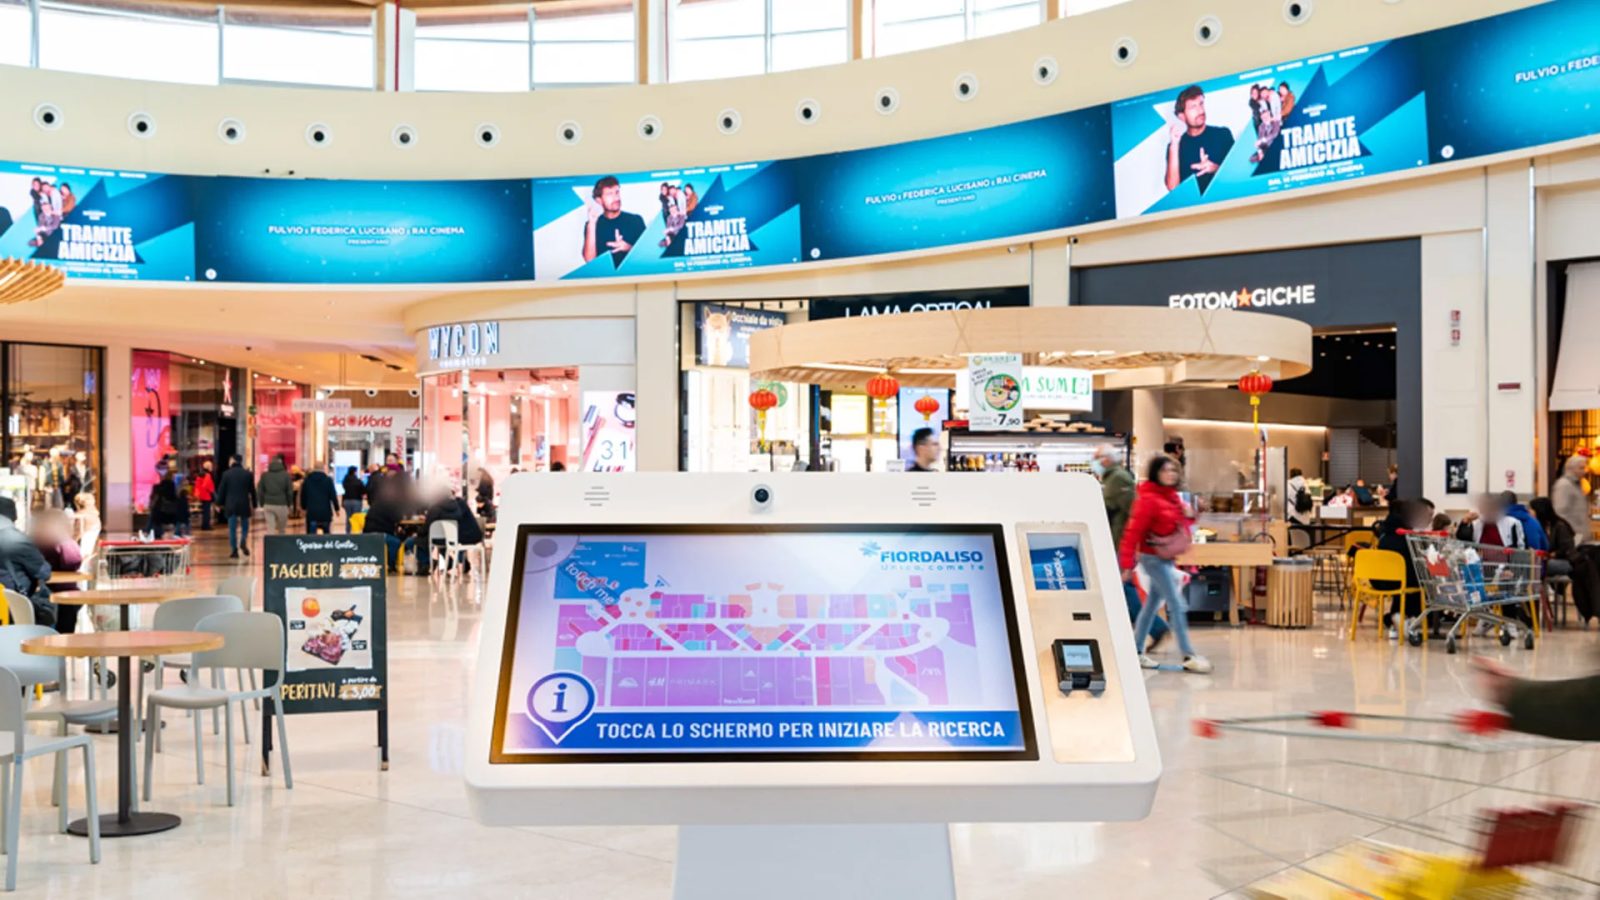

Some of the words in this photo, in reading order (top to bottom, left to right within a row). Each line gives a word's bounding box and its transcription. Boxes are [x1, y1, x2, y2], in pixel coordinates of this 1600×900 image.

[1515, 65, 1559, 83] FULVIO
[1281, 115, 1356, 149] TRAMITE
[1279, 136, 1361, 170] AMICIZIA
[865, 193, 897, 204] FULVIO
[903, 186, 945, 199] FEDERICA
[946, 179, 990, 193] LUCISANO
[996, 175, 1011, 184] RAI
[1013, 169, 1047, 181] CINEMA
[60, 223, 132, 244] TRAMITE
[268, 225, 304, 234] FULVIO
[310, 225, 356, 234] FEDERICA
[358, 226, 405, 235] LUCISANO
[412, 226, 427, 235] RAI
[429, 226, 465, 234] CINEMA
[685, 217, 747, 238] TRAMITE
[57, 241, 136, 262] AMICIZIA
[684, 234, 751, 256] AMICIZIA
[1169, 284, 1316, 310] FOTOMGICHE
[428, 320, 499, 360] WYCON
[357, 415, 393, 428] World
[881, 550, 983, 563] FIORDALISO
[269, 561, 333, 580] TAGLIERI
[595, 588, 615, 605] me
[271, 681, 336, 701] PERITIVI
[597, 723, 656, 739] TOCCA
[661, 723, 684, 739] LO
[690, 723, 774, 739] SCHERMO
[779, 722, 813, 739] PER
[818, 722, 895, 738] INIZIARE
[900, 722, 922, 738] LA
[928, 721, 1005, 738] RICERCA
